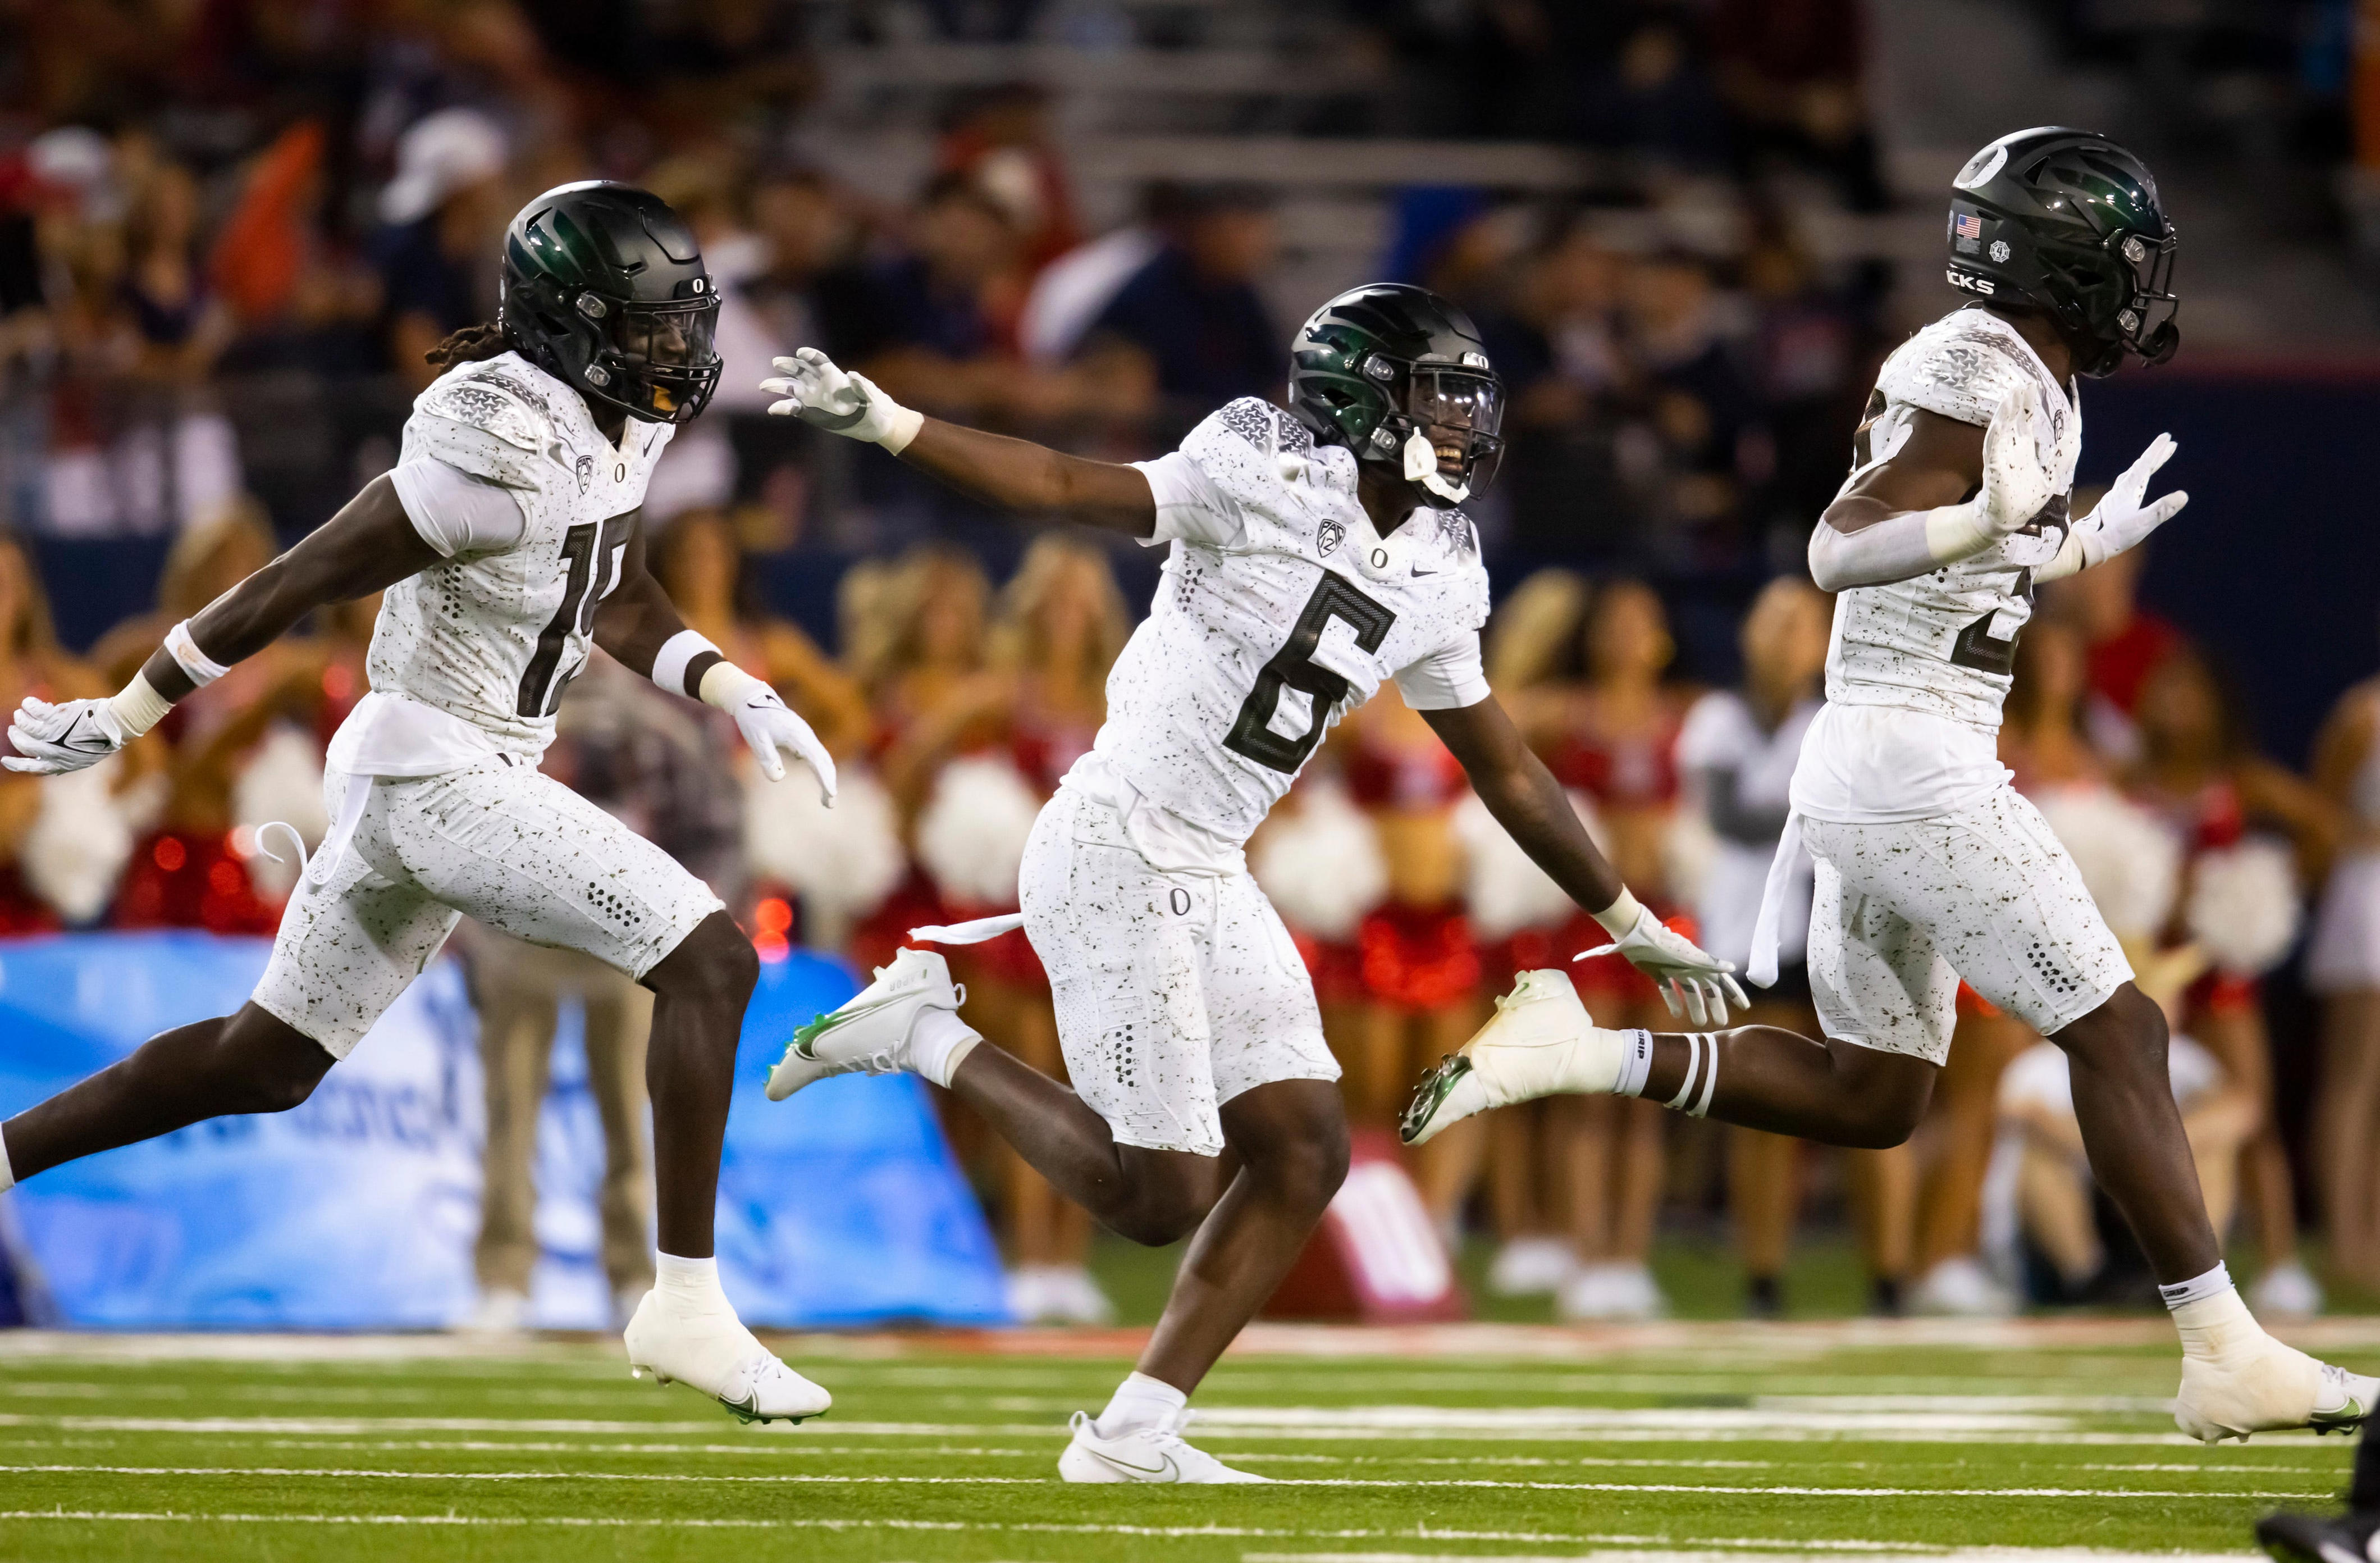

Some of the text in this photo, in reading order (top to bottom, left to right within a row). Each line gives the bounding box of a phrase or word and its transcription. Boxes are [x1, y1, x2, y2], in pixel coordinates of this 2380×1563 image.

[1997, 246, 2003, 257] 4
[580, 472, 588, 487] 12
[1319, 521, 1344, 546] PAC
[1320, 536, 1335, 551] 12
[1221, 568, 1397, 775] 6
